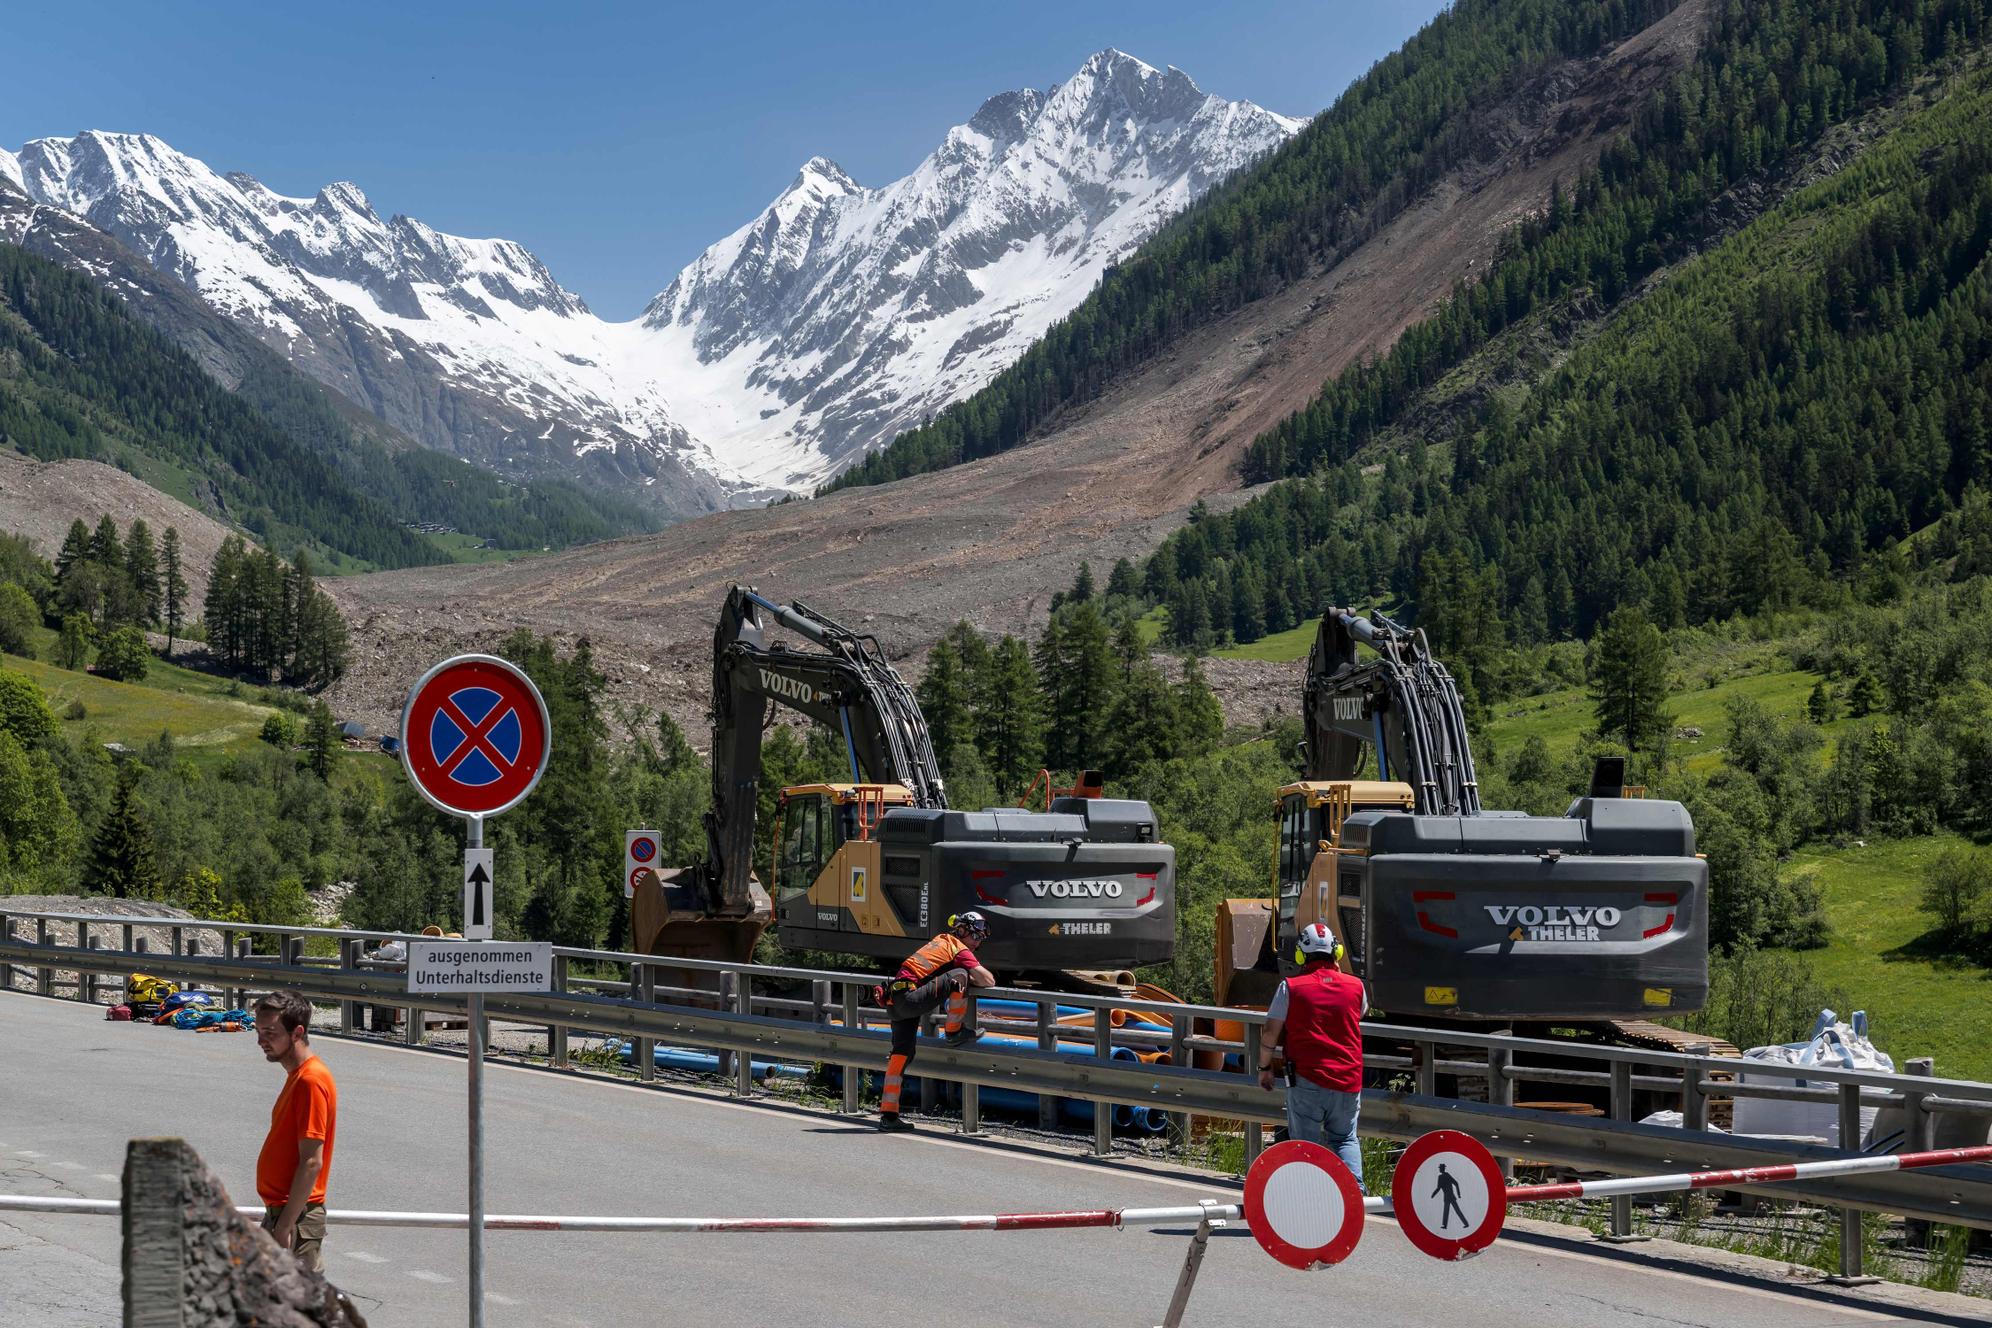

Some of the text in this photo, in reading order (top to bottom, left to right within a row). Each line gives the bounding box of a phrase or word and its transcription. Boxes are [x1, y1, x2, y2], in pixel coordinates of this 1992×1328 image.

[759, 668, 812, 703] VOLVO
[1026, 880, 1122, 898] VOLVO
[817, 912, 838, 922] VOLVO
[1484, 905, 1622, 926] VOLVO
[1062, 922, 1111, 935] THELER
[1528, 926, 1600, 941] THELER
[428, 951, 532, 967] ausgenommen
[416, 969, 544, 985] Unterhaltsdienste
